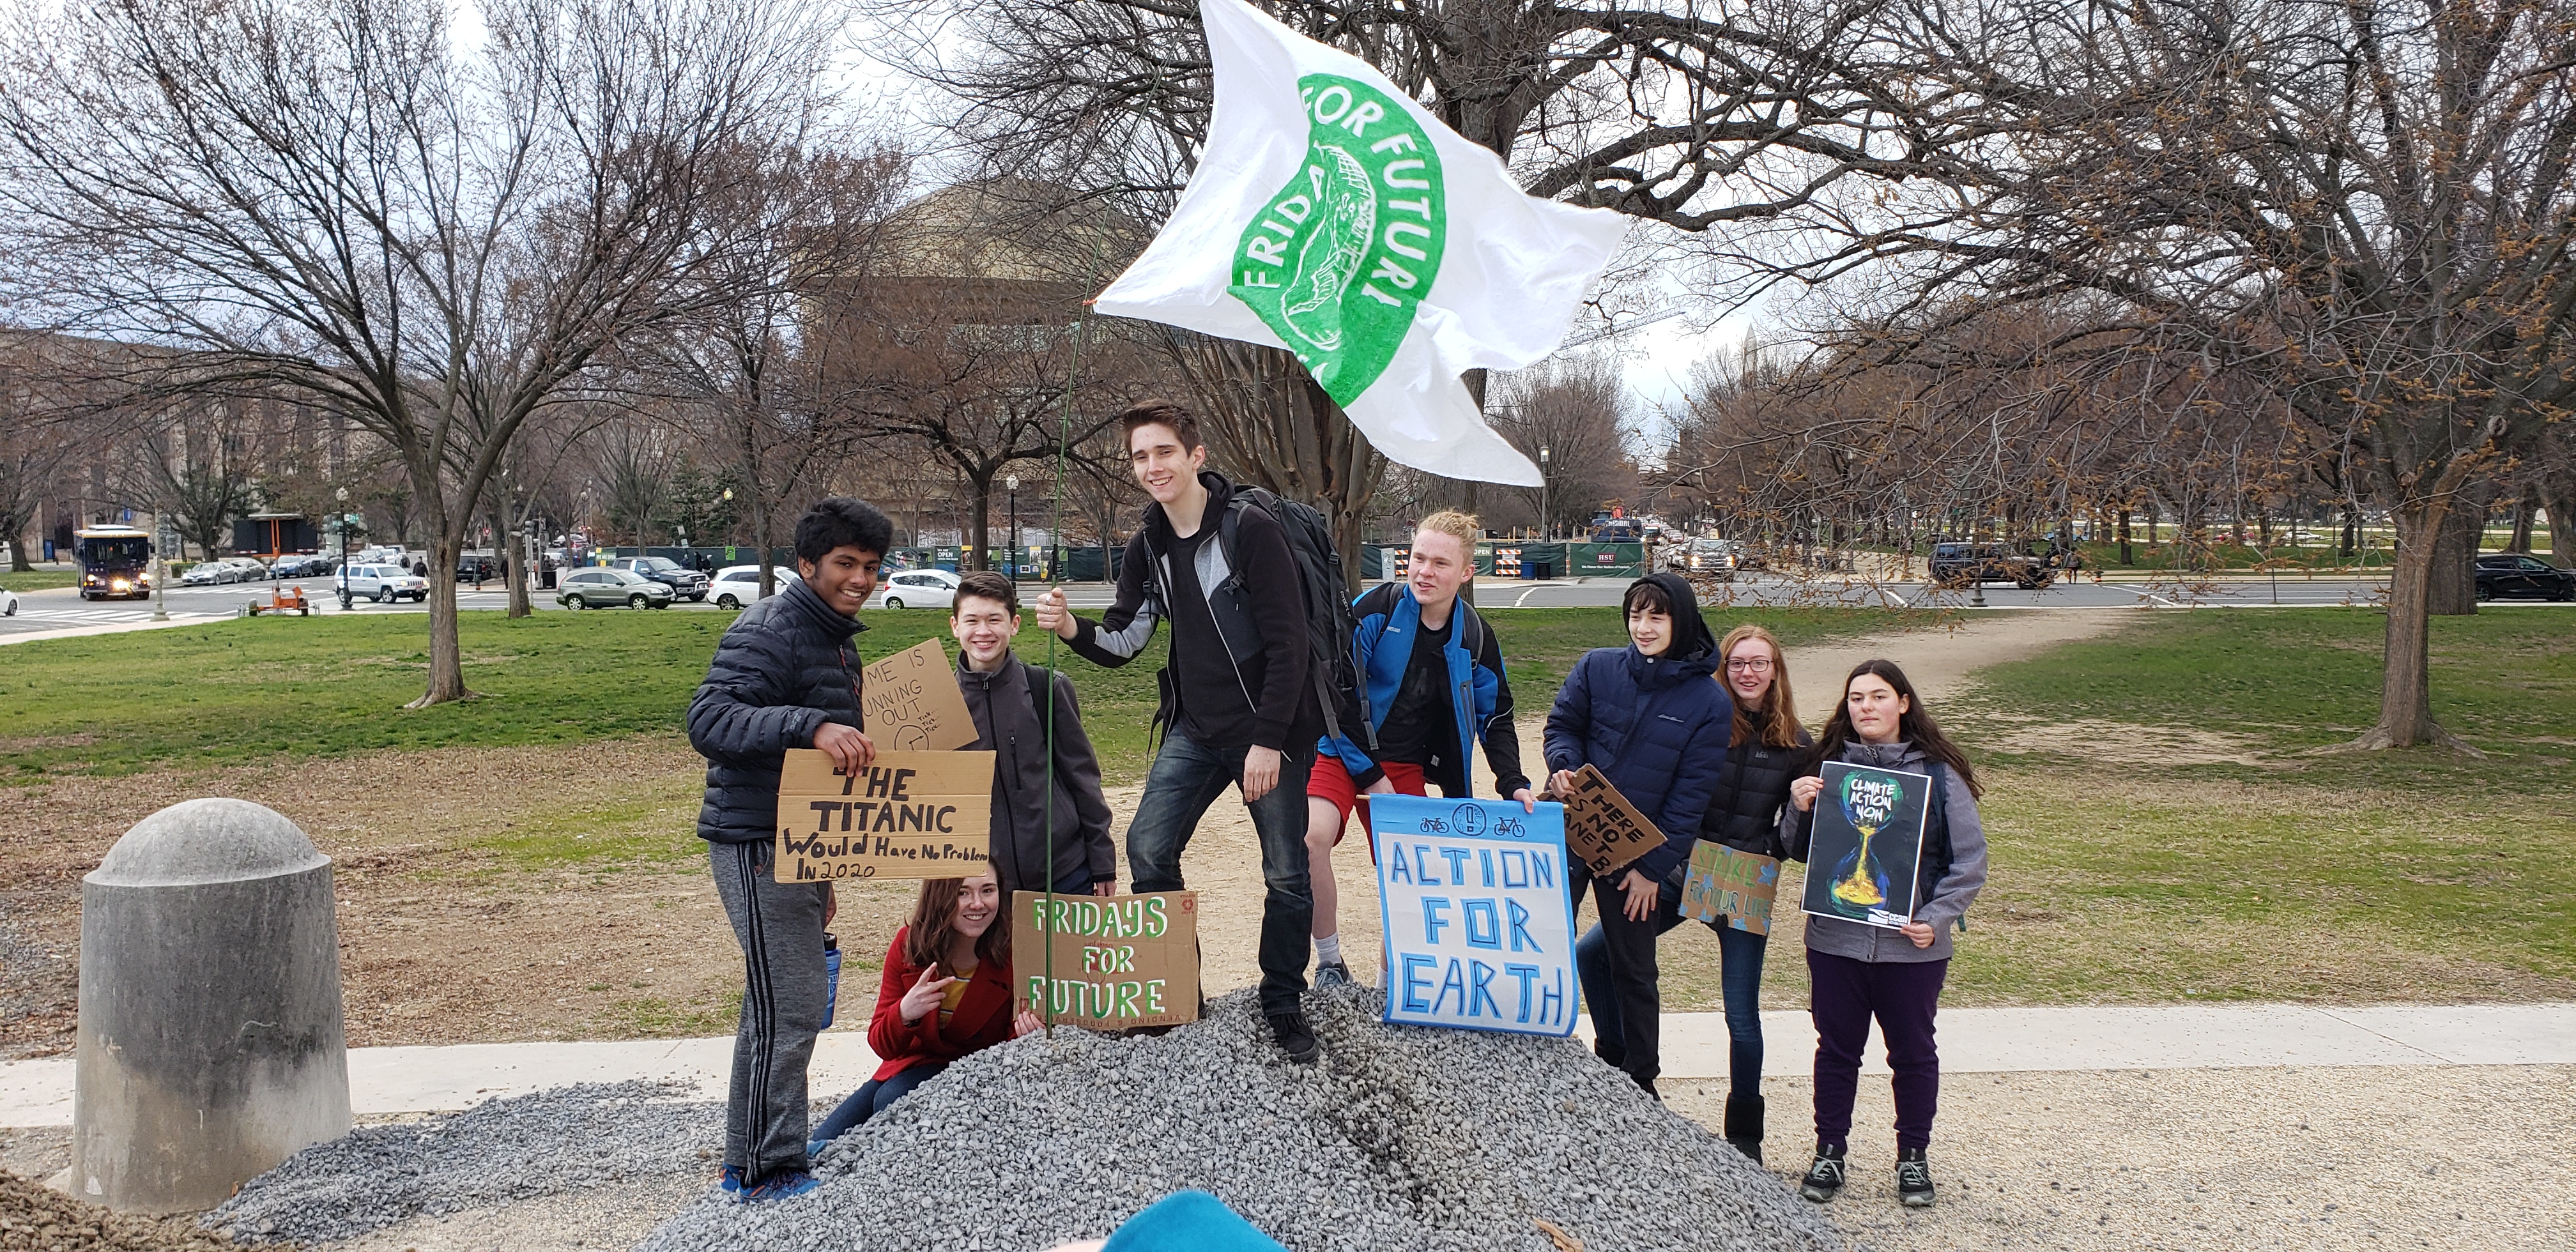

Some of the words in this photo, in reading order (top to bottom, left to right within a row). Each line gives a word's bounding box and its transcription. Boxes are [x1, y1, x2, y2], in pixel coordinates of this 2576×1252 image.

[1301, 86, 1384, 137] FOR
[1245, 164, 1324, 288] FRIDA
[862, 660, 898, 690] IME
[908, 649, 924, 669] IS
[862, 679, 922, 717] UNNING
[882, 698, 919, 726] OUT
[832, 767, 916, 801] THE
[1851, 779, 1896, 797] CLIMATE
[810, 800, 956, 833] TITANIC
[1579, 770, 1645, 843] THERE
[1850, 791, 1892, 811] ACTION
[1856, 805, 1883, 822] NOW
[783, 828, 868, 858] Would
[875, 837, 916, 860] Have
[922, 844, 940, 860] No
[943, 843, 988, 861] Problem
[1586, 813, 1620, 843] NO
[820, 862, 875, 879] 2020
[1391, 841, 1554, 889] ACTION
[1591, 855, 1611, 871] B
[1694, 844, 1760, 888] STRIKE
[1033, 896, 1168, 938] FRIDAYS
[1708, 887, 1739, 915] YOUR
[1744, 894, 1771, 920] LIFE
[1889, 913, 1908, 924] ccan
[1420, 897, 1544, 953] FOR
[1083, 945, 1135, 974] FOR
[1029, 975, 1165, 1018] FUTURE
[1400, 952, 1563, 1026] EARTH
[1036, 1014, 1110, 1028] FOODSERVE
[1131, 1014, 1181, 1027] VENDING
